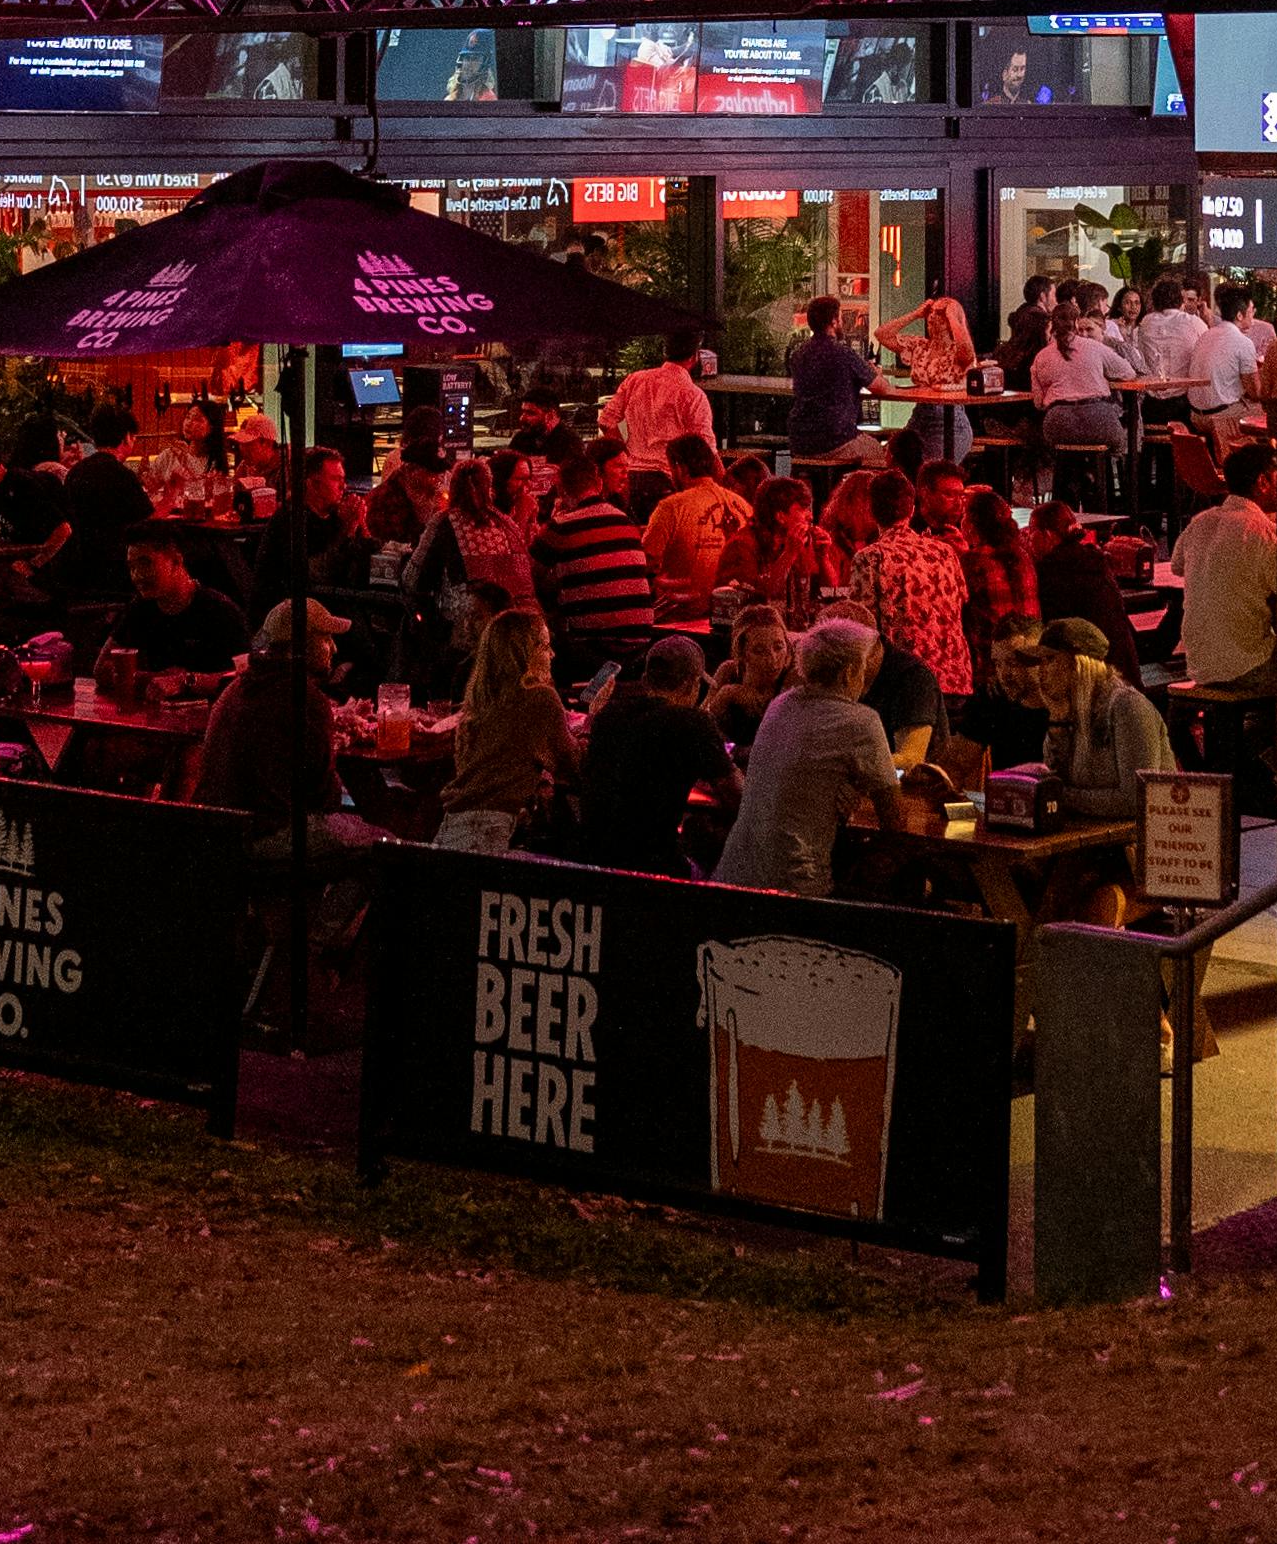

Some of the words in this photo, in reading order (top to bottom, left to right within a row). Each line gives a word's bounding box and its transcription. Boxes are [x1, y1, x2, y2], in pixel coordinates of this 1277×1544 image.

[61, 38, 92, 49] ABOUT
[94, 39, 105, 50] TO
[107, 39, 133, 51] LOSE.
[354, 278, 373, 294] 4
[371, 276, 460, 295] PINES
[103, 289, 128, 307] 4
[117, 288, 188, 308] PINES
[352, 294, 495, 314] BREWING
[65, 308, 174, 329] BREWING
[417, 316, 476, 335] CO.
[76, 330, 120, 349] CO.
[1148, 804, 1190, 816] PLEASE
[1192, 808, 1212, 818] SEE
[1168, 822, 1193, 835] OUR
[1154, 839, 1207, 853] FRIENDLY
[1147, 856, 1181, 868] STAFF
[1183, 857, 1197, 869] TO
[1199, 859, 1213, 871] BE
[478, 890, 603, 973] FRESH
[474, 969, 599, 1062] BEER
[470, 1054, 597, 1154] HERE
